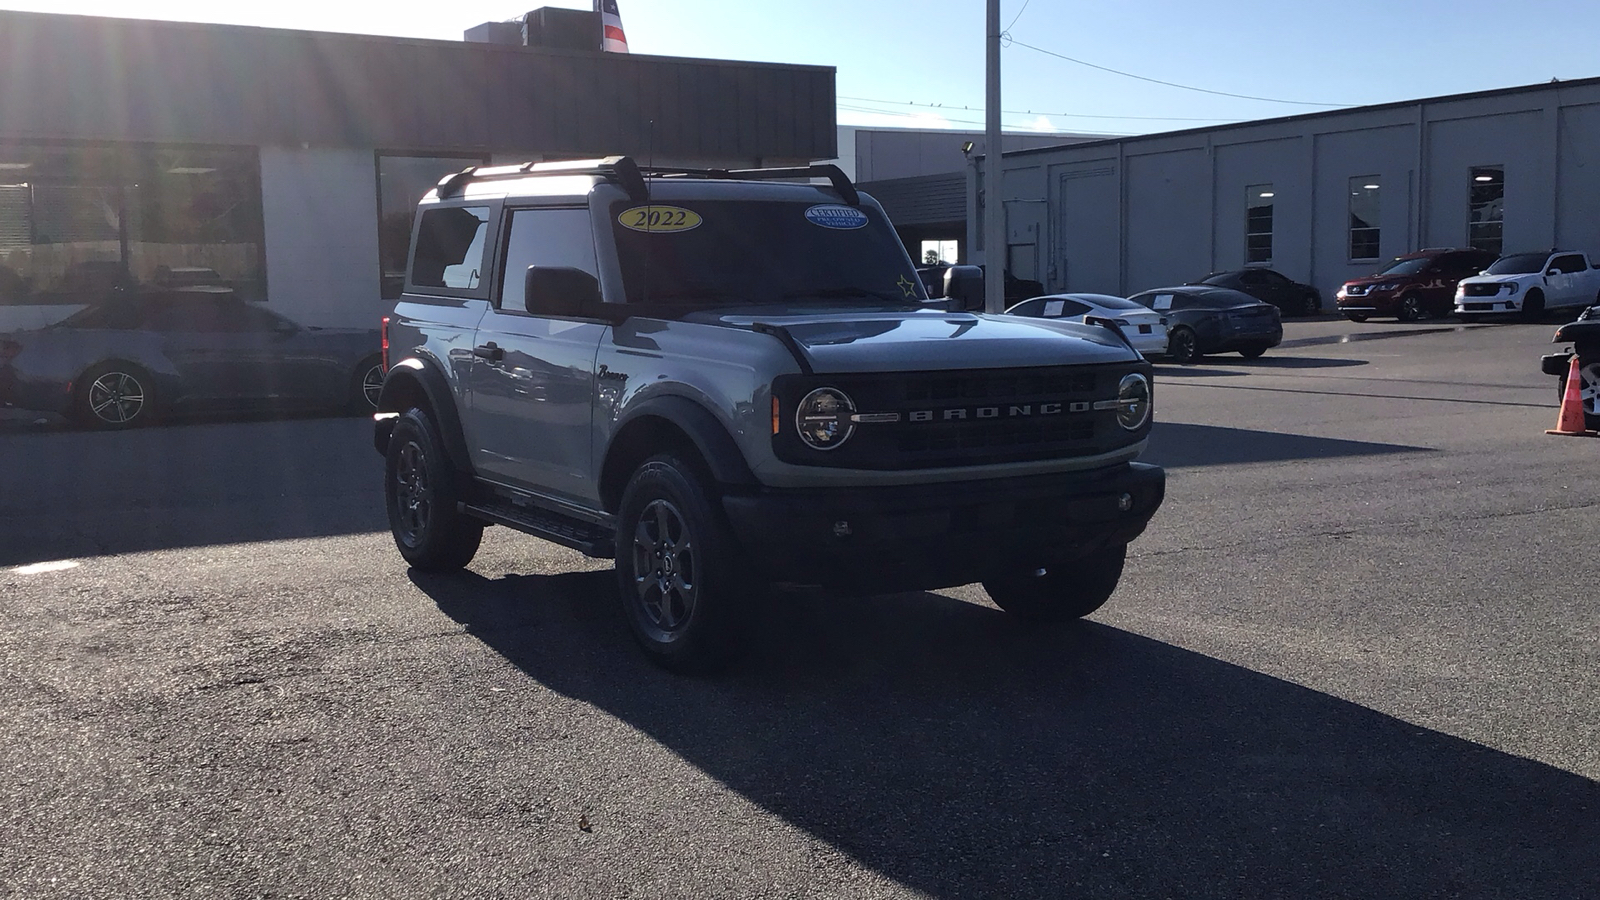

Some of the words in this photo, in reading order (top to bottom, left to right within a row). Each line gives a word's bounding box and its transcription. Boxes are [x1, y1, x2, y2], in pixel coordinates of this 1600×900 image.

[633, 210, 687, 227] 2022
[810, 208, 860, 217] CERTIFIED
[909, 401, 1090, 422] BRONCO
